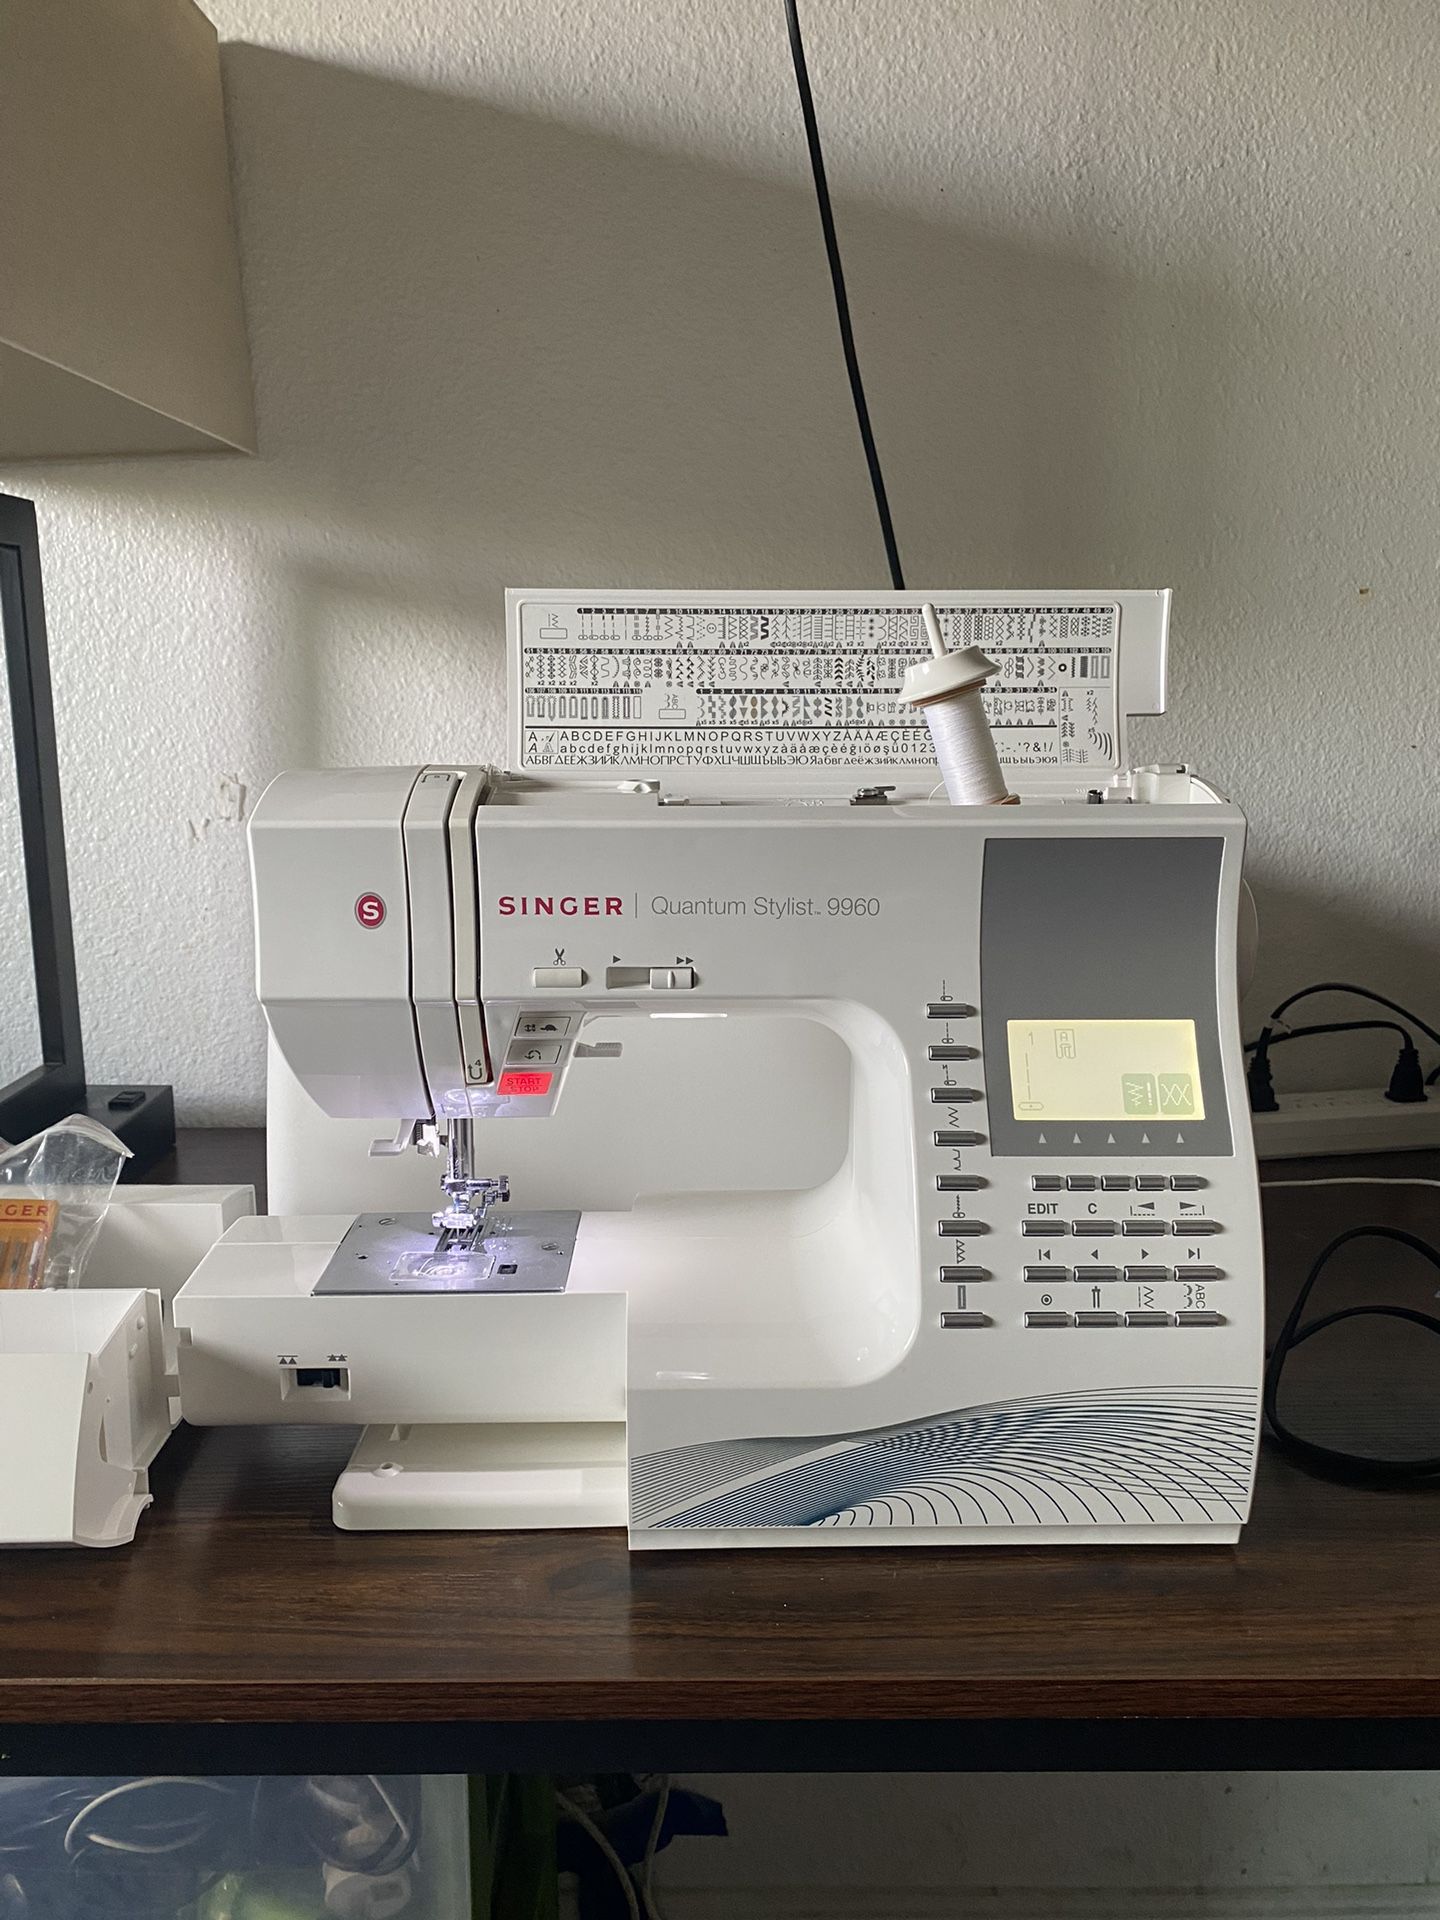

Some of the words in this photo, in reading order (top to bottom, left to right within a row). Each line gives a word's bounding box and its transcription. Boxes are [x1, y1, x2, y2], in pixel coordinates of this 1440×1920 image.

[498, 896, 624, 916] SINGER
[651, 896, 746, 916] Quantum
[827, 897, 880, 916] 9960
[507, 1077, 542, 1086] START
[510, 1085, 540, 1093] STOP
[1027, 1203, 1058, 1214] EDIT
[1087, 1203, 1097, 1214] C
[1194, 1283, 1206, 1309] ABC
